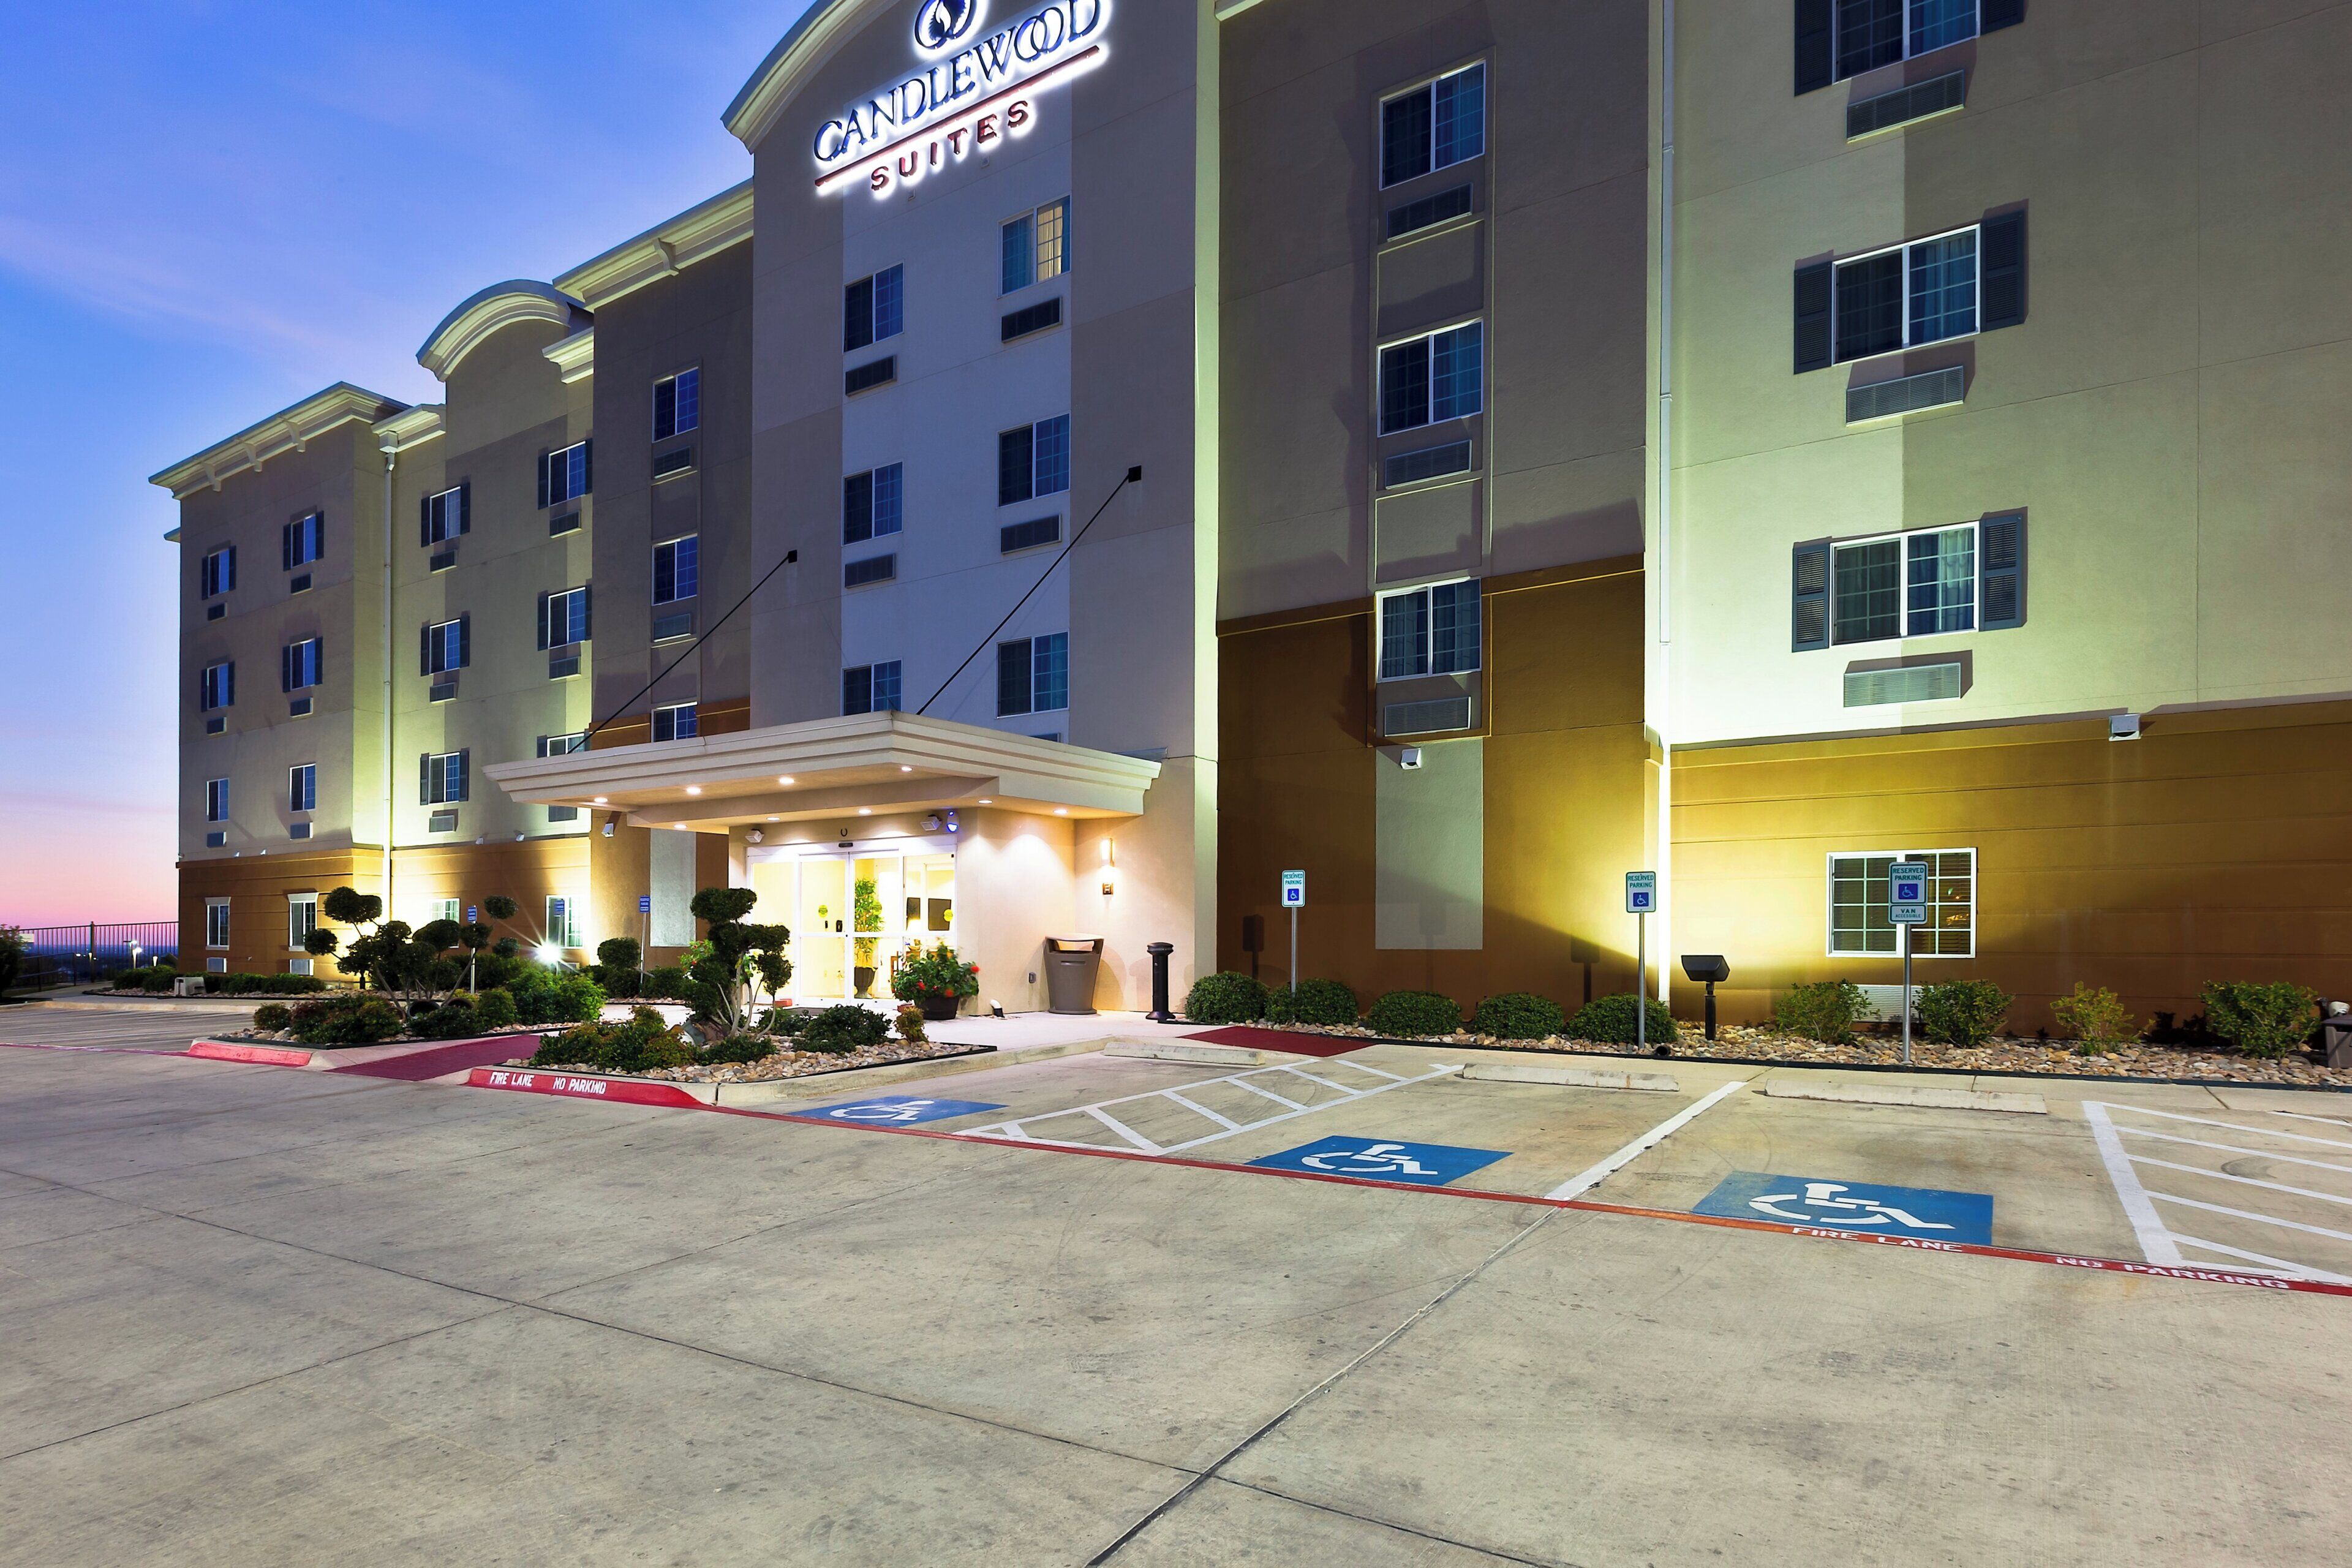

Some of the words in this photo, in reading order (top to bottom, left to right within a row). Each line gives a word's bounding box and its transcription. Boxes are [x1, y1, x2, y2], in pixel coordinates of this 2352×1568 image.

[813, 0, 1101, 162] CANDLEWOOD
[870, 100, 1029, 191] SUITES
[490, 1071, 510, 1085] FIRE
[511, 1073, 535, 1087] LANE
[552, 1077, 567, 1090] NO
[568, 1078, 607, 1095] PARKING
[1792, 1227, 1860, 1241] FIRE
[1877, 1236, 1963, 1252] LANE
[2056, 1256, 2103, 1268] NO
[2124, 1264, 2290, 1289] PARKING
